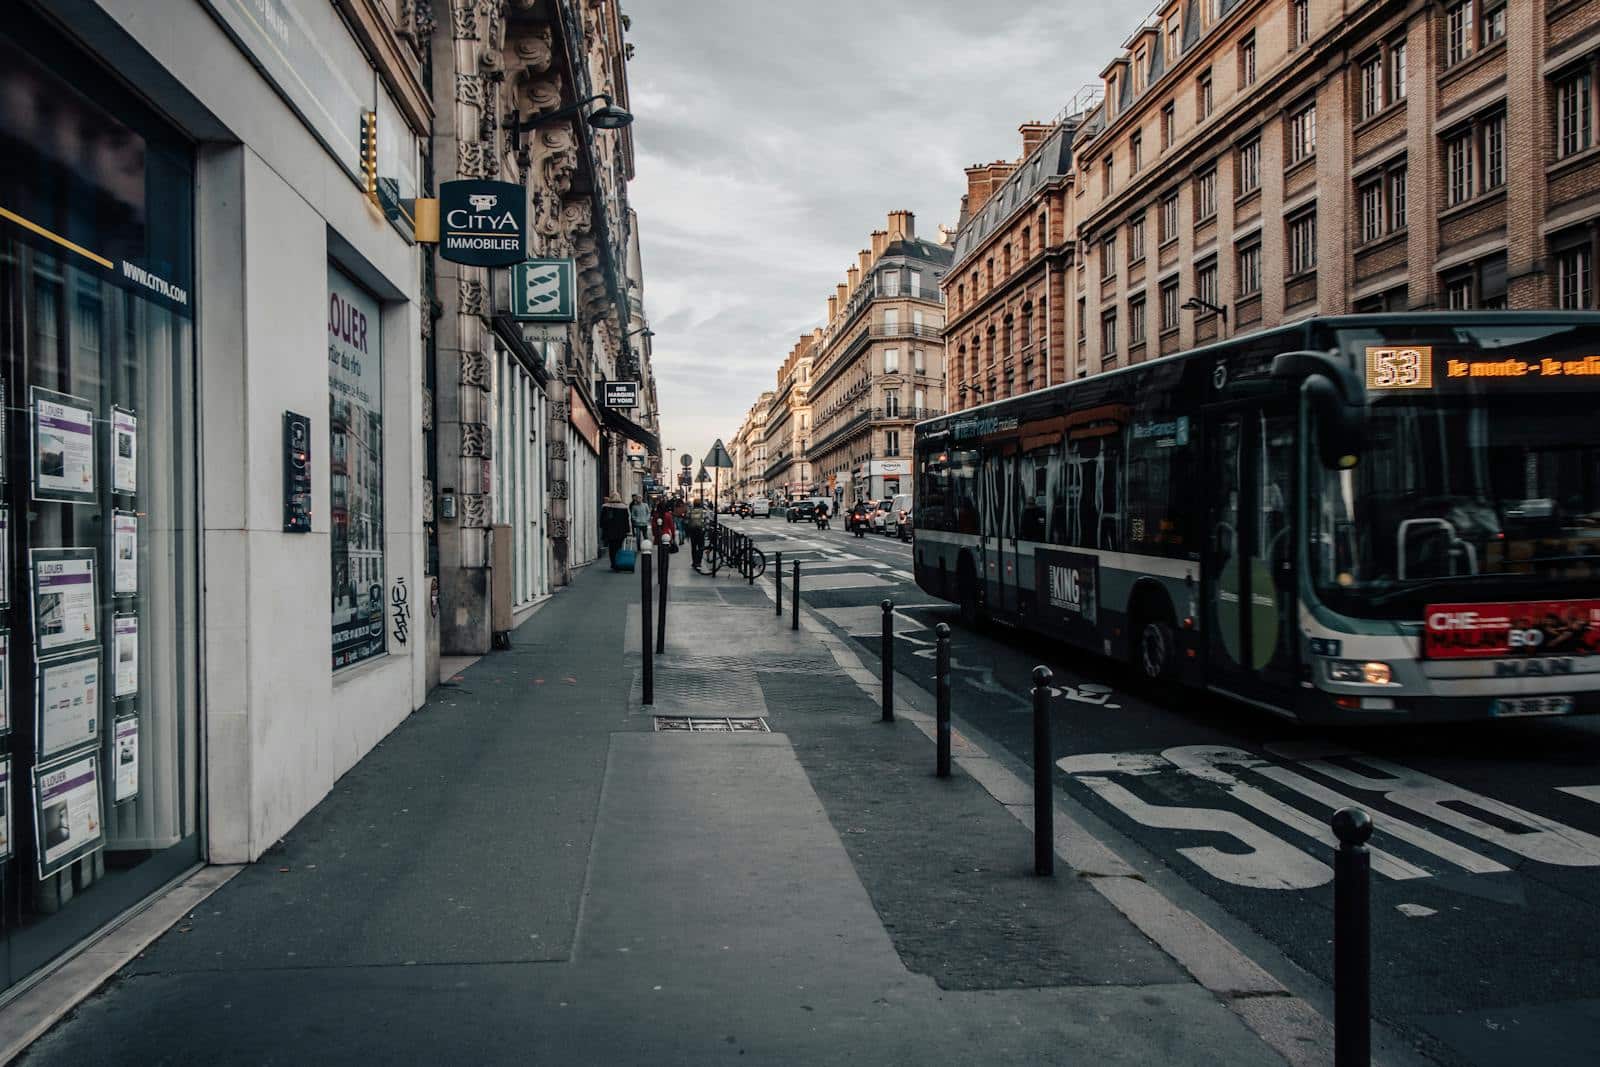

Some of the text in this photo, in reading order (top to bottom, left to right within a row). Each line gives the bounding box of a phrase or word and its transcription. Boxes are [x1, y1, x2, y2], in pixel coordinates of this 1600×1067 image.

[446, 238, 519, 250] IMMOBILIER
[122, 260, 187, 305] WWW.CITYA.COM
[327, 293, 368, 354] OUER
[1374, 350, 1420, 387] 53
[1053, 565, 1080, 604] KING
[1429, 611, 1479, 631] CHE
[1495, 658, 1573, 676] MAN
